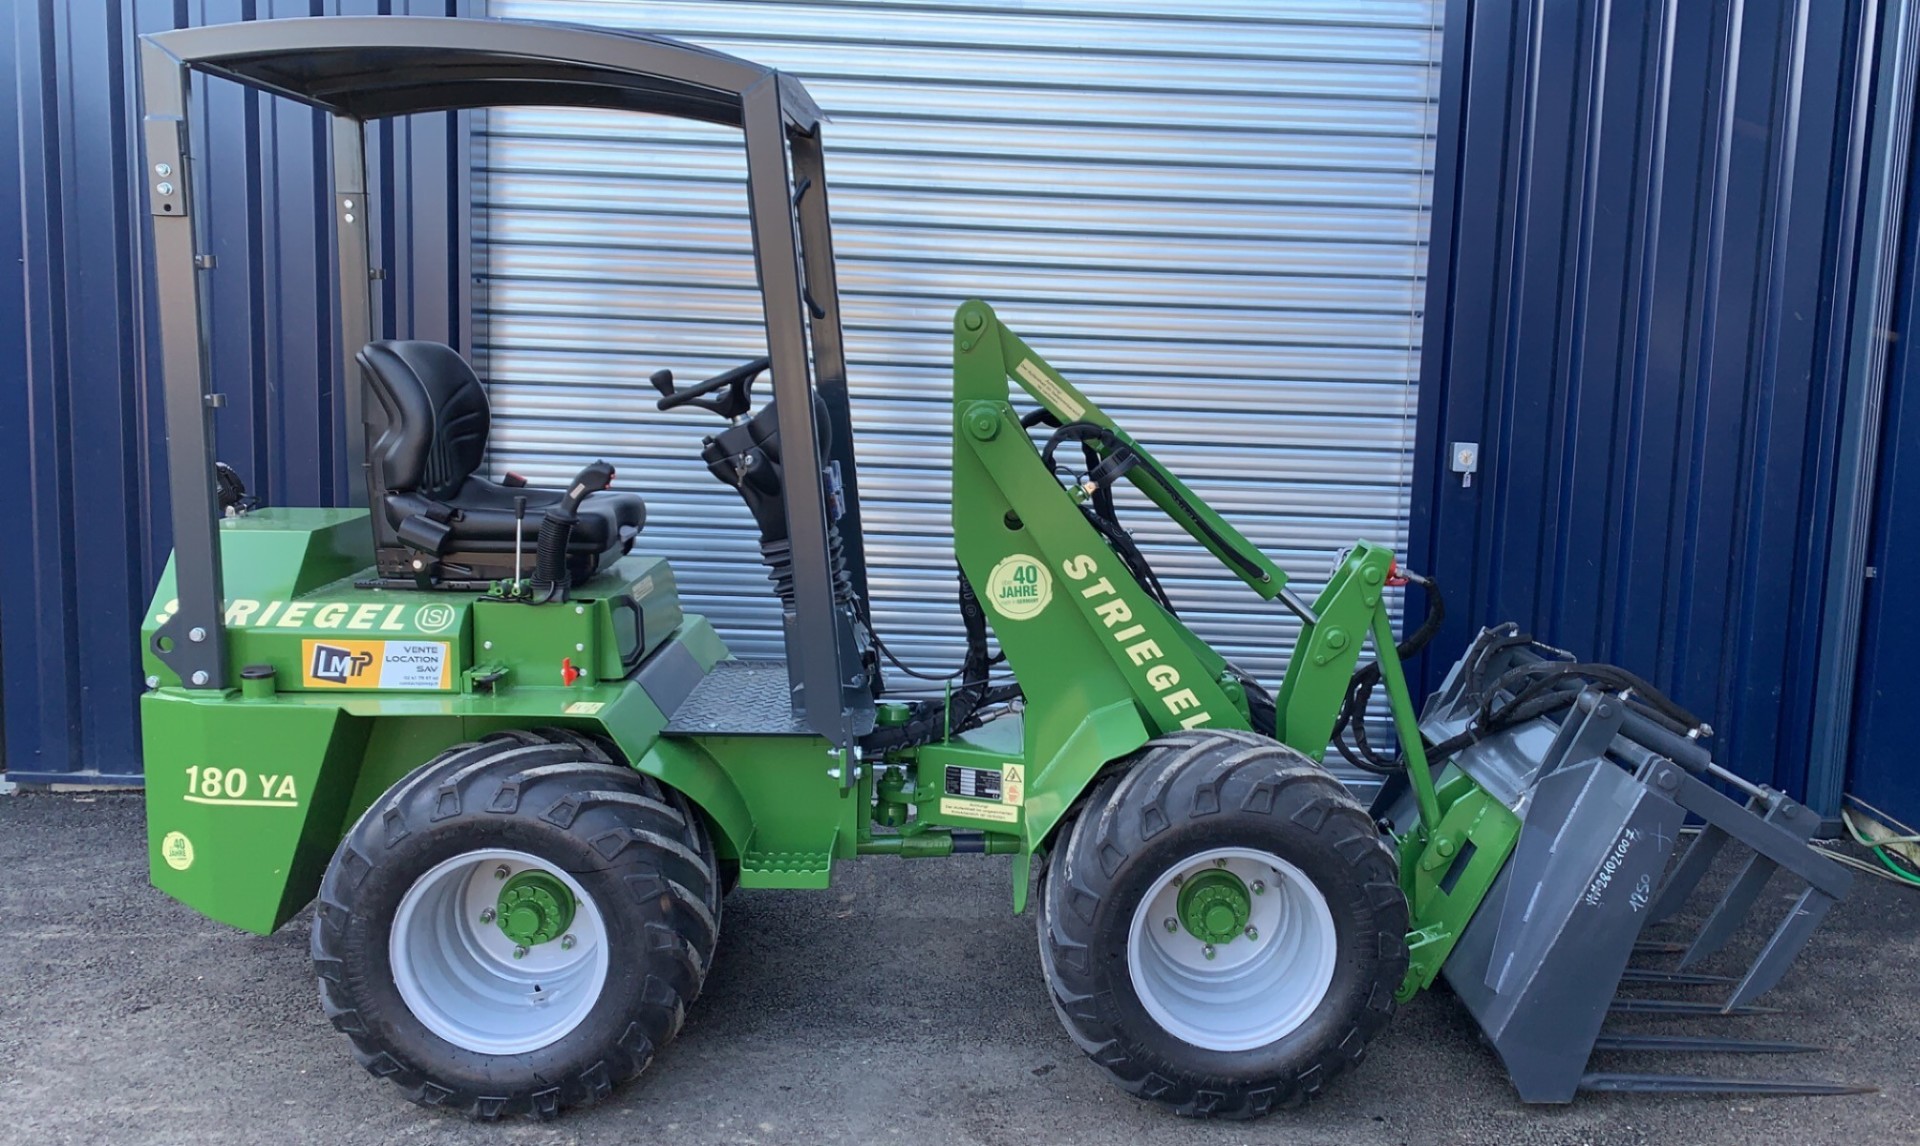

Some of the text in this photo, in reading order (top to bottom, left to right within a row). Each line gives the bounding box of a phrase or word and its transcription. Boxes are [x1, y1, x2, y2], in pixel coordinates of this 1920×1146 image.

[1013, 565, 1038, 584] 40
[999, 584, 1039, 598] JAHRE
[155, 598, 406, 631] SRIEGEL
[403, 646, 438, 654] VENTE
[1063, 554, 1212, 730] STRIEGEL
[385, 655, 439, 663] LOCATION
[416, 665, 438, 673] SAV
[185, 765, 298, 799] 180 YA
[173, 838, 186, 850] 40
[1629, 873, 1651, 913] 1250
